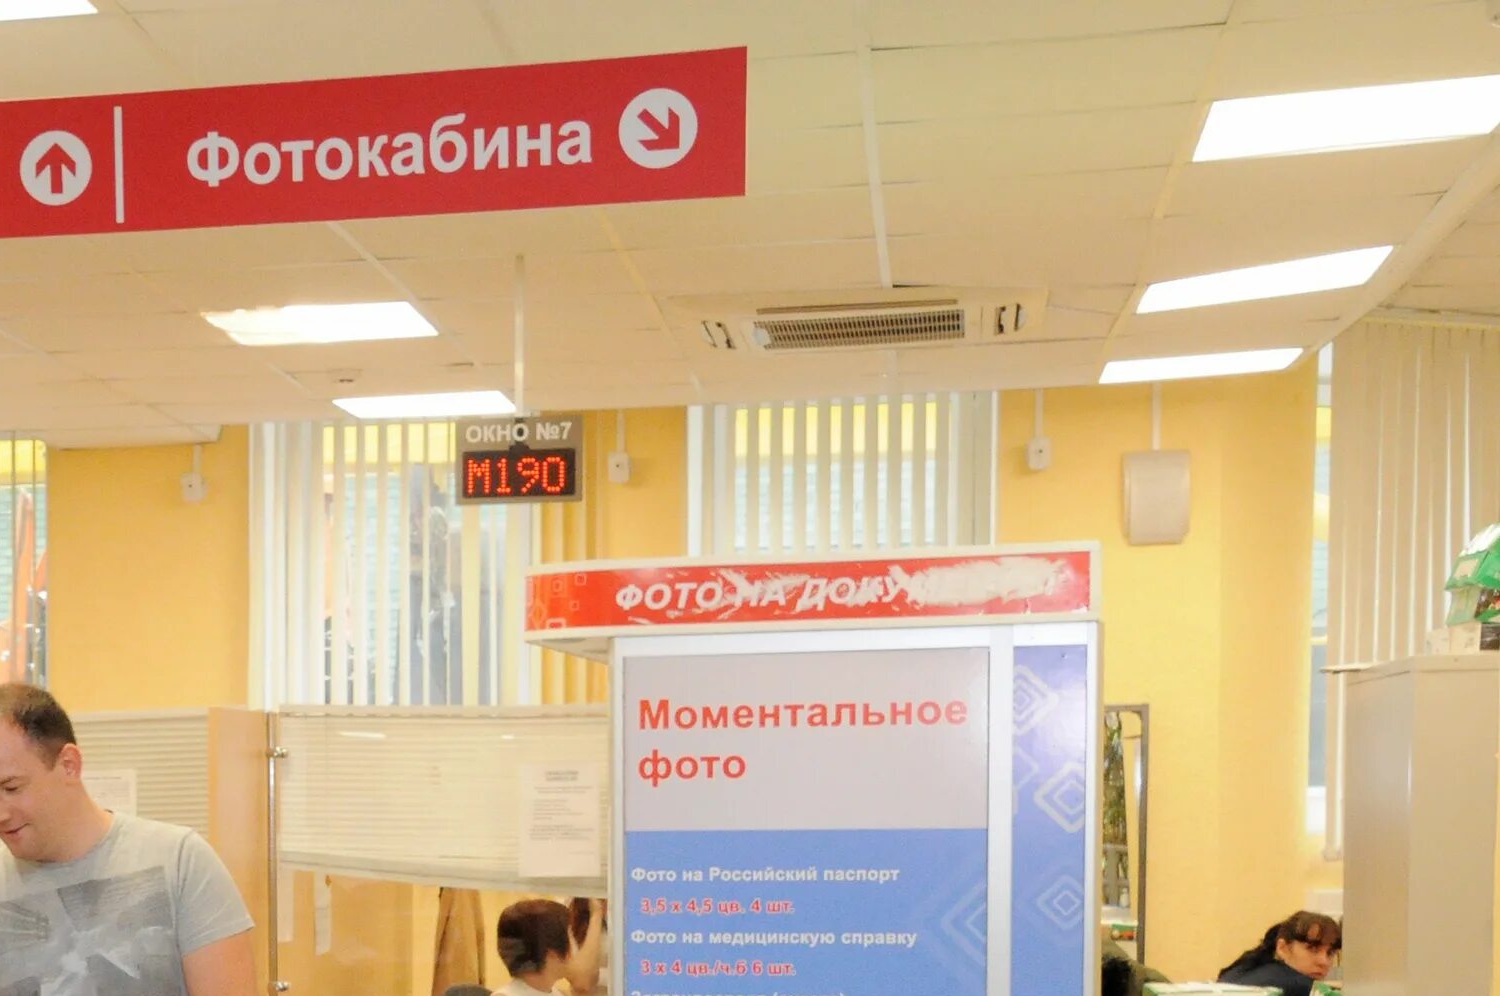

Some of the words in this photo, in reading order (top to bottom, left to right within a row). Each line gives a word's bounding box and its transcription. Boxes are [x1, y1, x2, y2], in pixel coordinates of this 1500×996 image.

[187, 113, 592, 187] Фотокабина
[466, 423, 529, 443] ОКНО
[536, 422, 572, 440] №7
[467, 457, 565, 493] М190
[616, 581, 723, 611] ФОТО
[639, 699, 968, 730] Моментальное
[638, 749, 746, 788] фото
[631, 867, 676, 882] Фото
[683, 869, 703, 881] на
[709, 866, 817, 882] Российский
[824, 868, 900, 883] паспорт
[641, 898, 666, 915] 3,5
[687, 899, 713, 915] 4,5
[718, 902, 745, 915] цв.
[750, 899, 761, 913] 4
[766, 902, 795, 913] шт.
[631, 930, 676, 944] Фото
[683, 932, 702, 944] на
[709, 931, 835, 947] медицинскую
[841, 932, 917, 947] справку
[641, 960, 650, 974] 3
[671, 961, 682, 974] 4
[752, 961, 762, 974] 6
[768, 964, 797, 975] шт.
